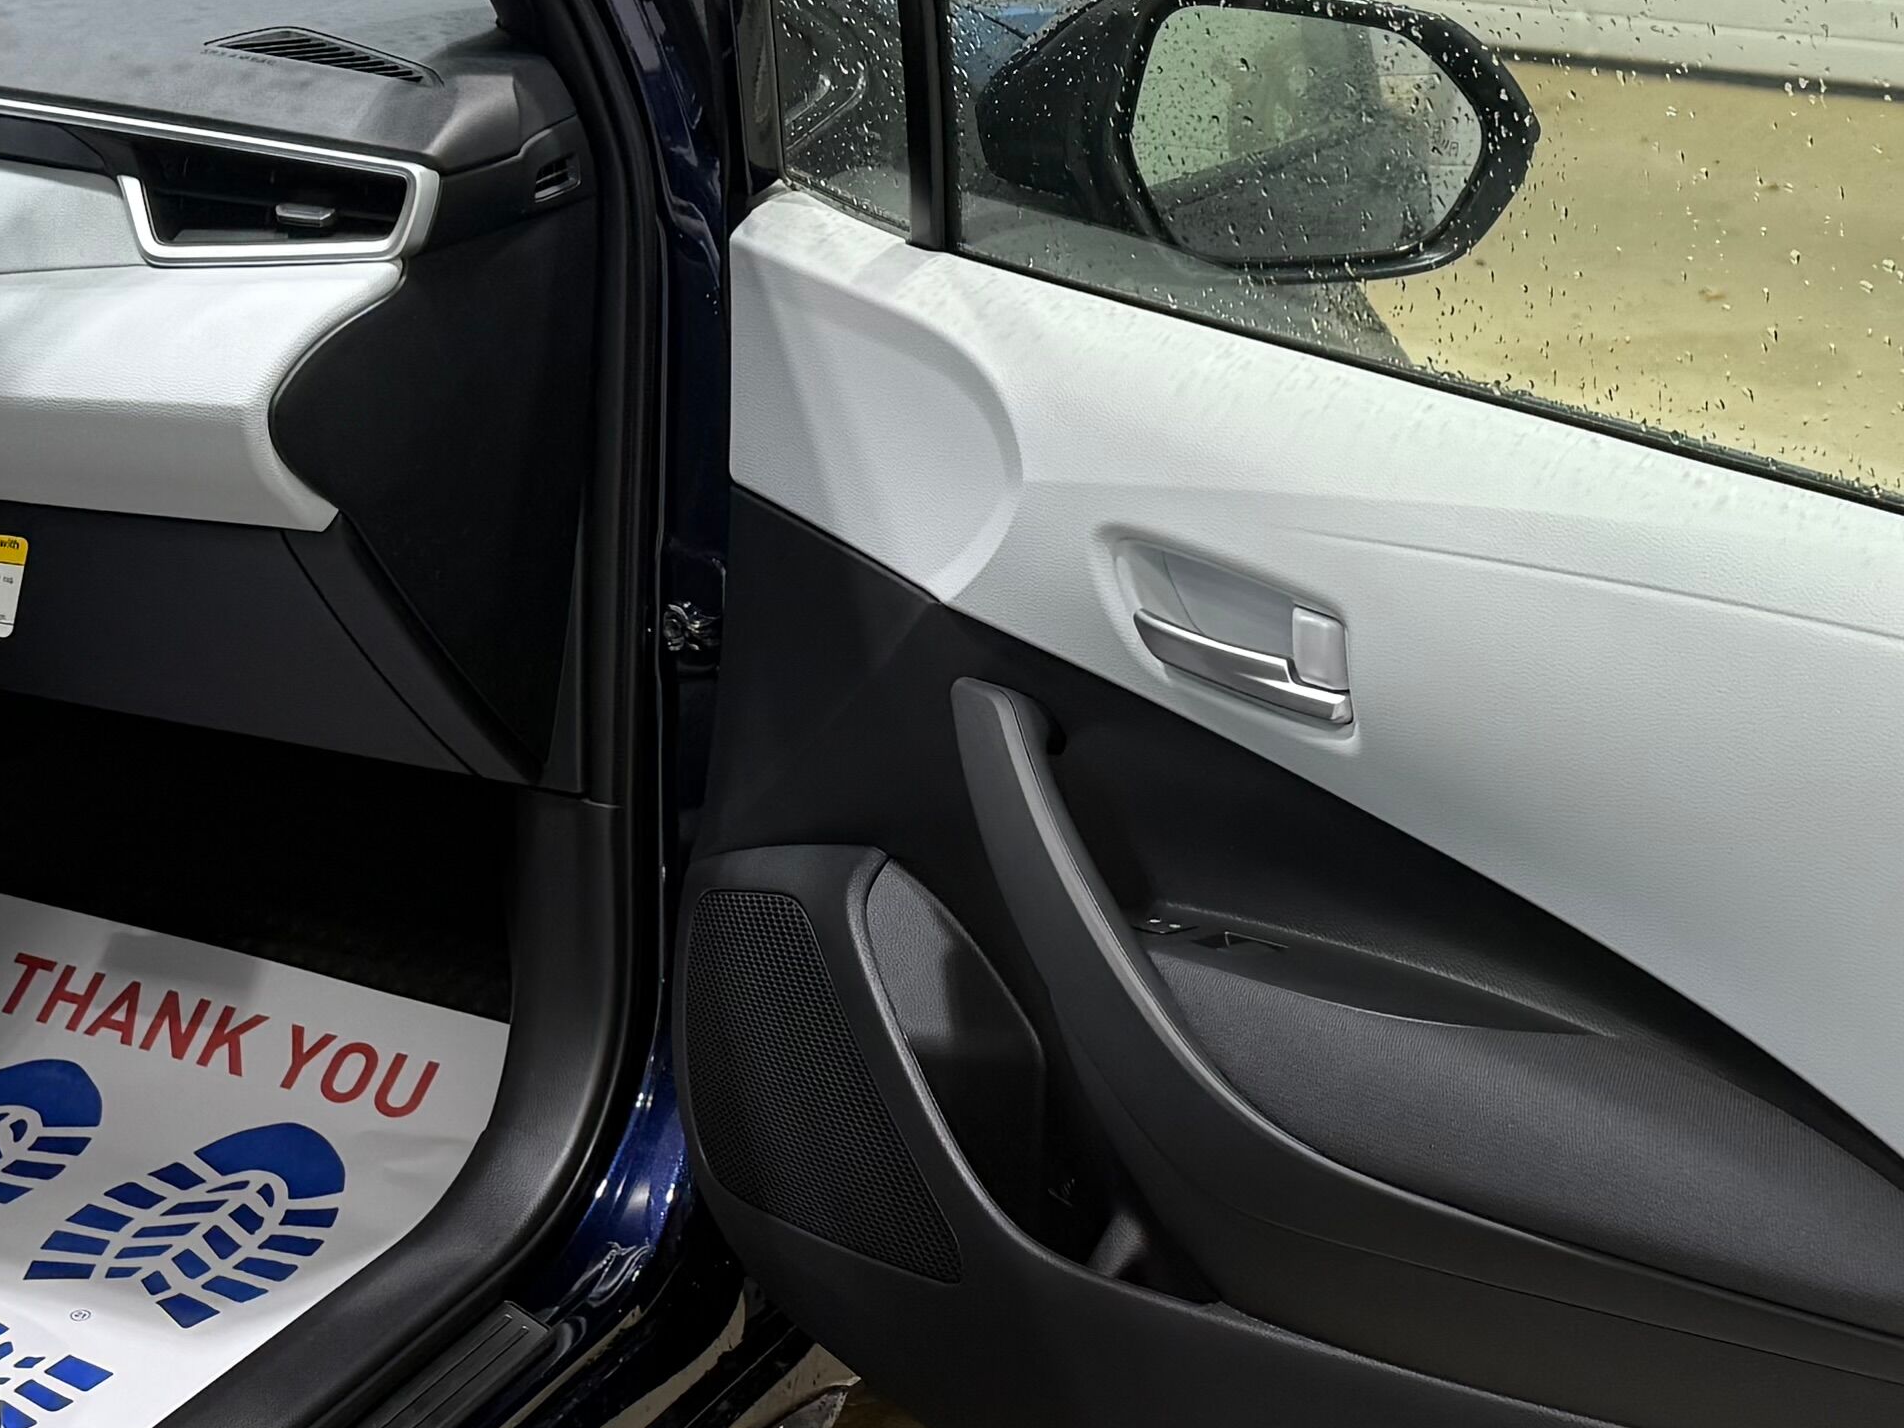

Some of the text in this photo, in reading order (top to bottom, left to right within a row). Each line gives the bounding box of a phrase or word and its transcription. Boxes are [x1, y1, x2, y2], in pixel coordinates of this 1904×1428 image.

[0, 538, 20, 550] with
[0, 952, 440, 1118] THANK YOU
